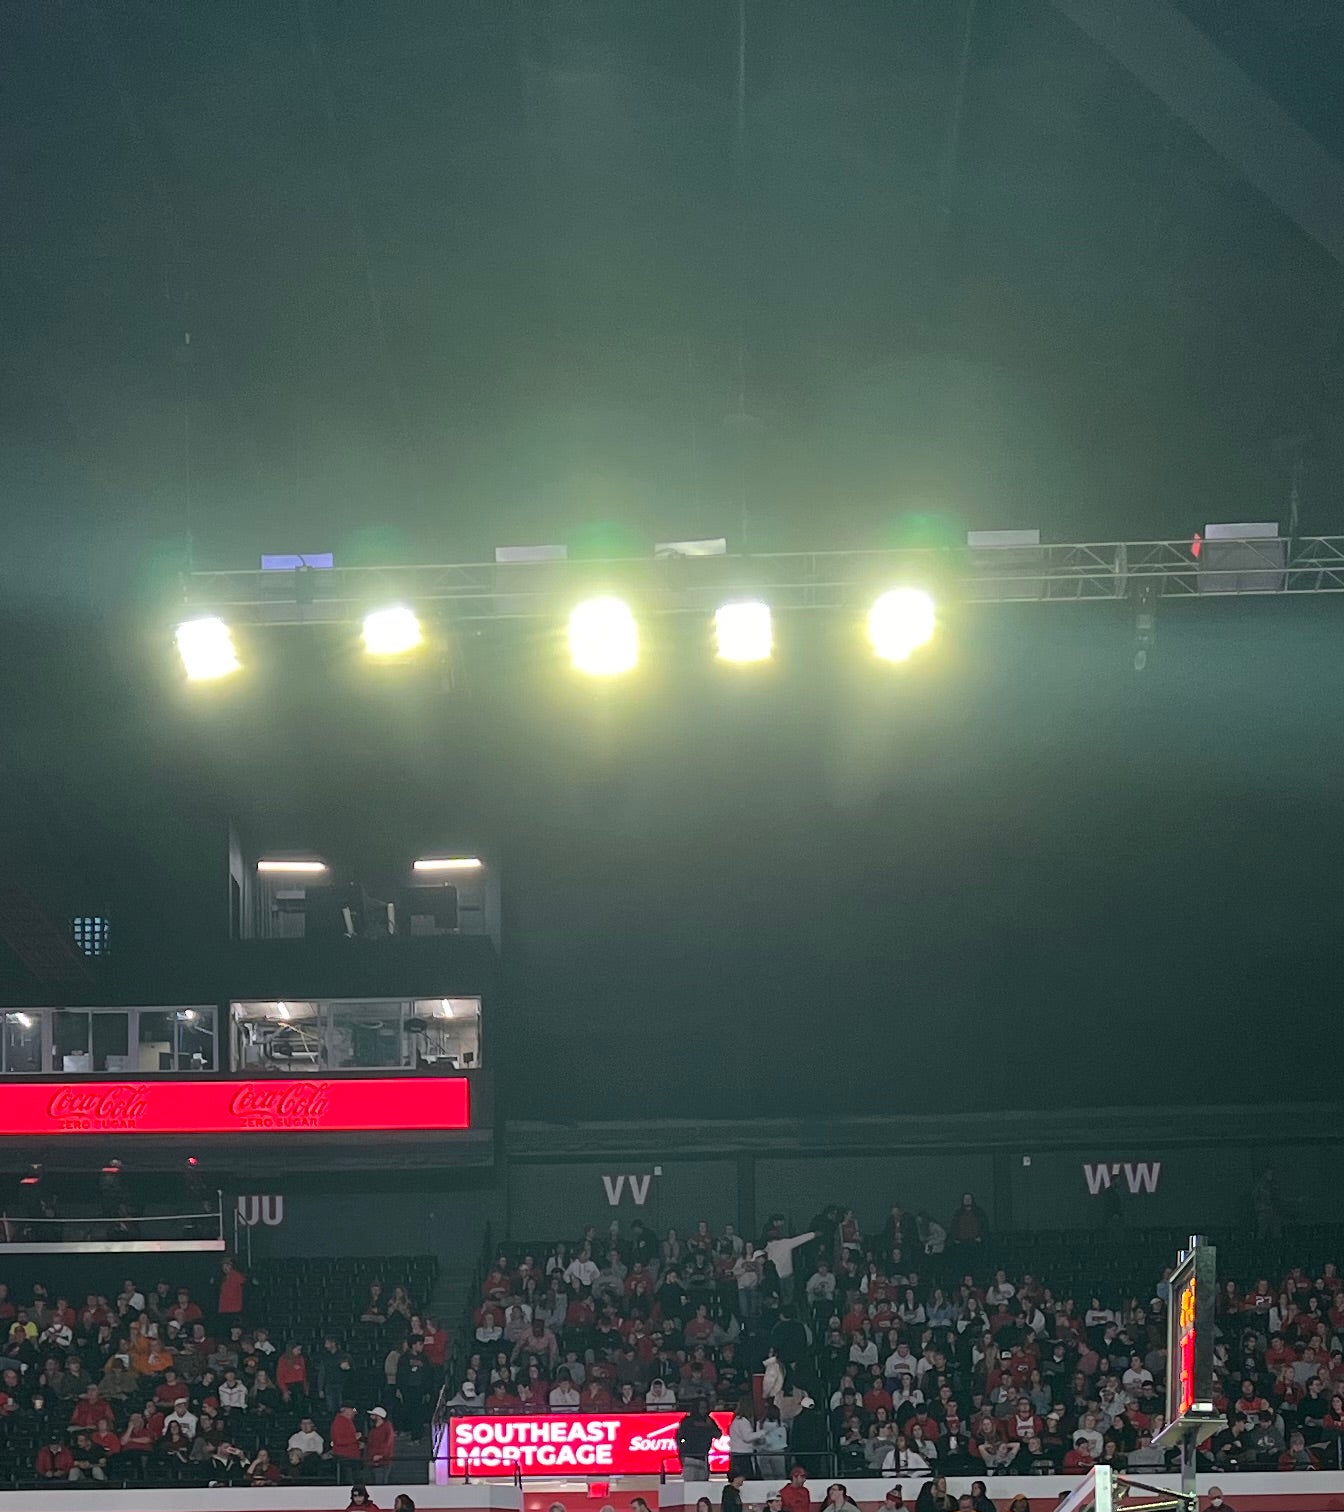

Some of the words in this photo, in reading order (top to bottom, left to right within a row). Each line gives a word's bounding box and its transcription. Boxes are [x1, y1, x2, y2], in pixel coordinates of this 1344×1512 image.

[58, 1119, 92, 1130] ZERO
[94, 1119, 136, 1130] SUGAR
[239, 1117, 274, 1128] ZERO
[276, 1116, 319, 1127] SUGAR
[601, 1175, 651, 1206] VV
[1084, 1163, 1161, 1194] WW
[238, 1196, 284, 1226] UU
[456, 1421, 621, 1445] SOUTHEAST
[457, 1444, 614, 1468] MORTGAGE
